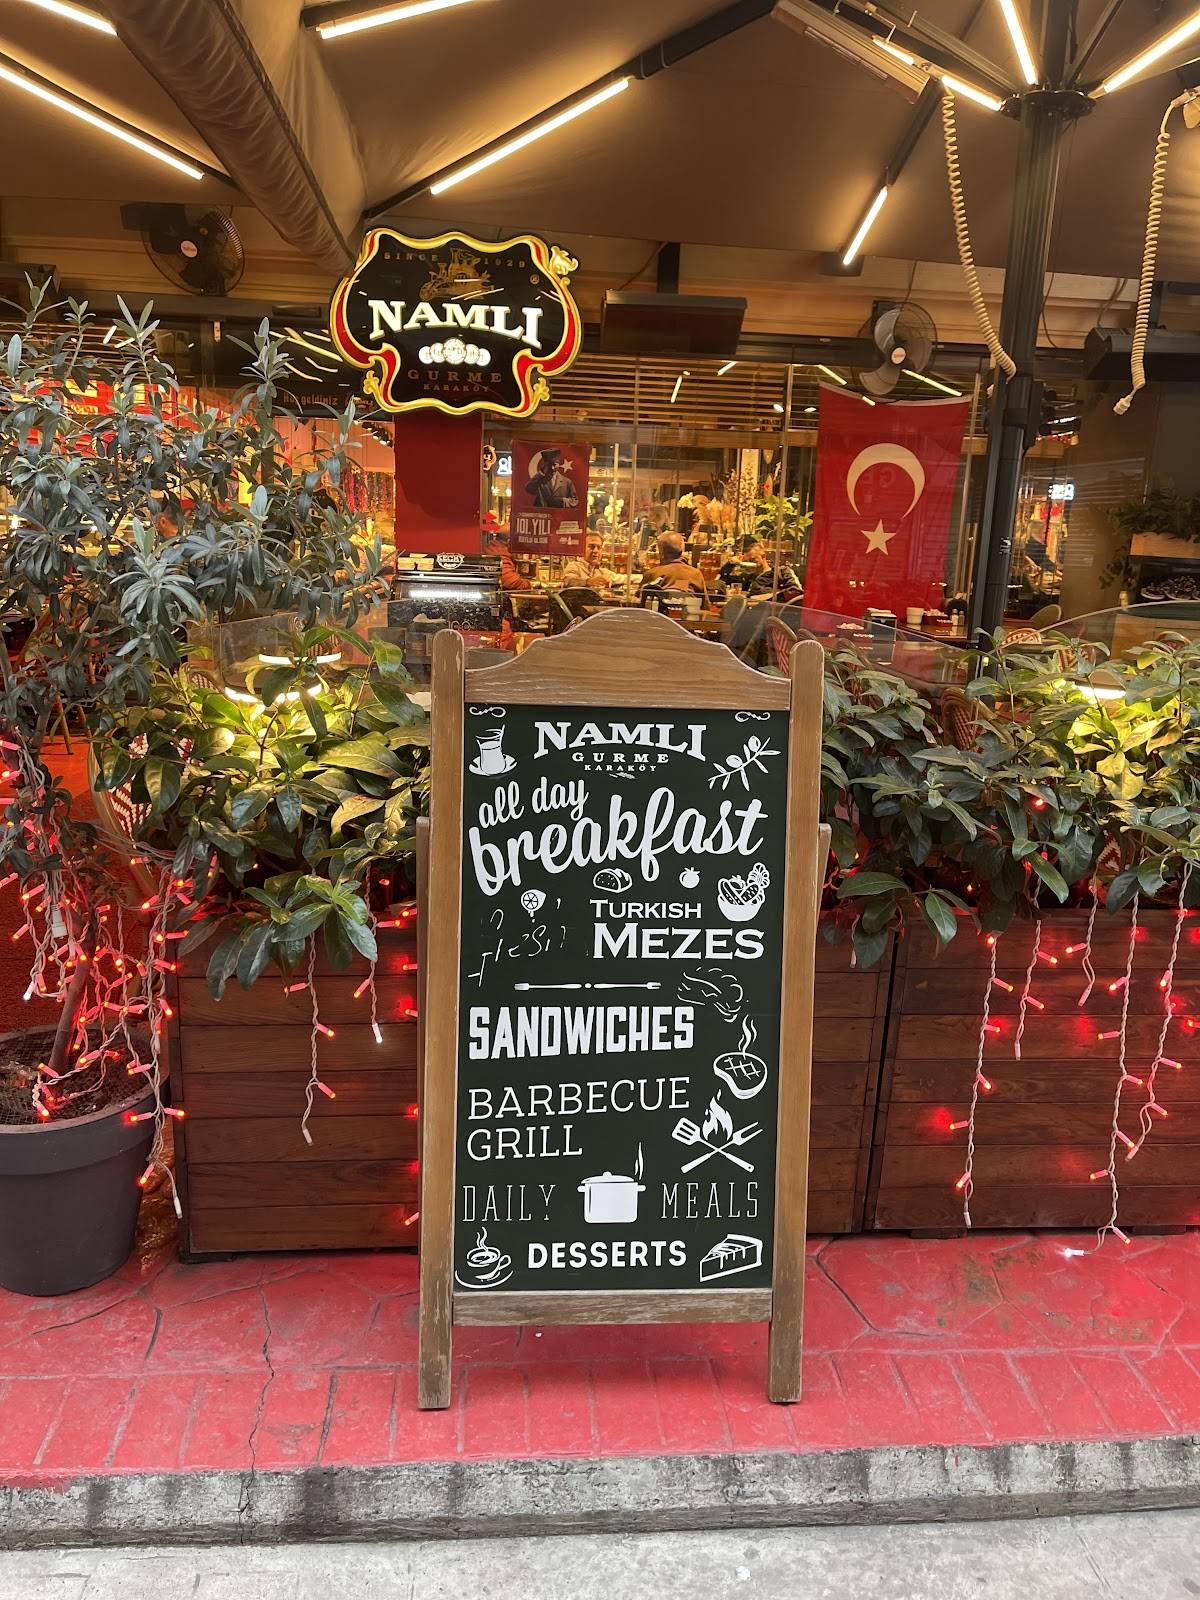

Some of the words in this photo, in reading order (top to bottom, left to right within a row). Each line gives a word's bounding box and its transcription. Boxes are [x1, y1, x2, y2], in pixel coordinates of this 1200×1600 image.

[367, 299, 544, 350] NAMLI
[407, 369, 502, 383] GURME
[533, 721, 707, 762] NAMLI
[571, 751, 669, 763] GURME
[584, 764, 657, 772] KARAKÖY
[478, 781, 524, 829] all
[532, 776, 589, 820] day
[468, 787, 769, 897] breakfast
[469, 1006, 694, 1060] SANDWICHES
[468, 1076, 690, 1120] BARBECUE
[467, 1124, 583, 1162] GRILL
[462, 1184, 556, 1222] DAILY
[660, 1182, 758, 1219] MEALS
[527, 1240, 687, 1269] DESSERTS
